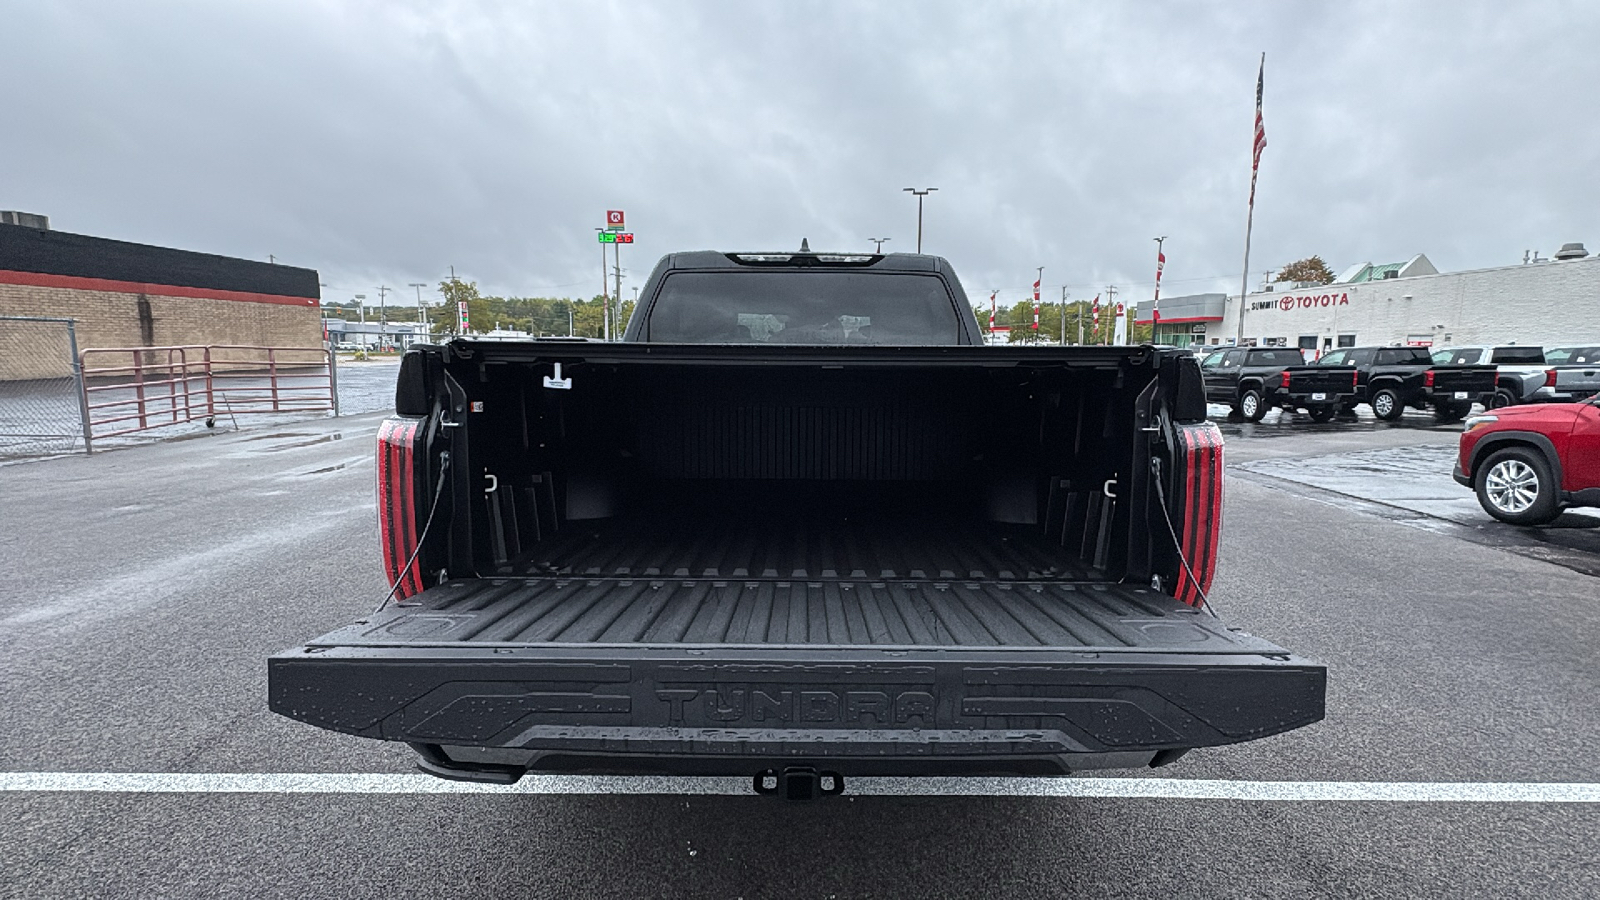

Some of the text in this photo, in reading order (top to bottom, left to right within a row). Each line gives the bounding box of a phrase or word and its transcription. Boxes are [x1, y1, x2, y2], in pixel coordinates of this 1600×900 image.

[612, 213, 619, 221] K
[1251, 293, 1349, 311] SUMMIT TOYOTA
[655, 689, 935, 723] TUNDRA
